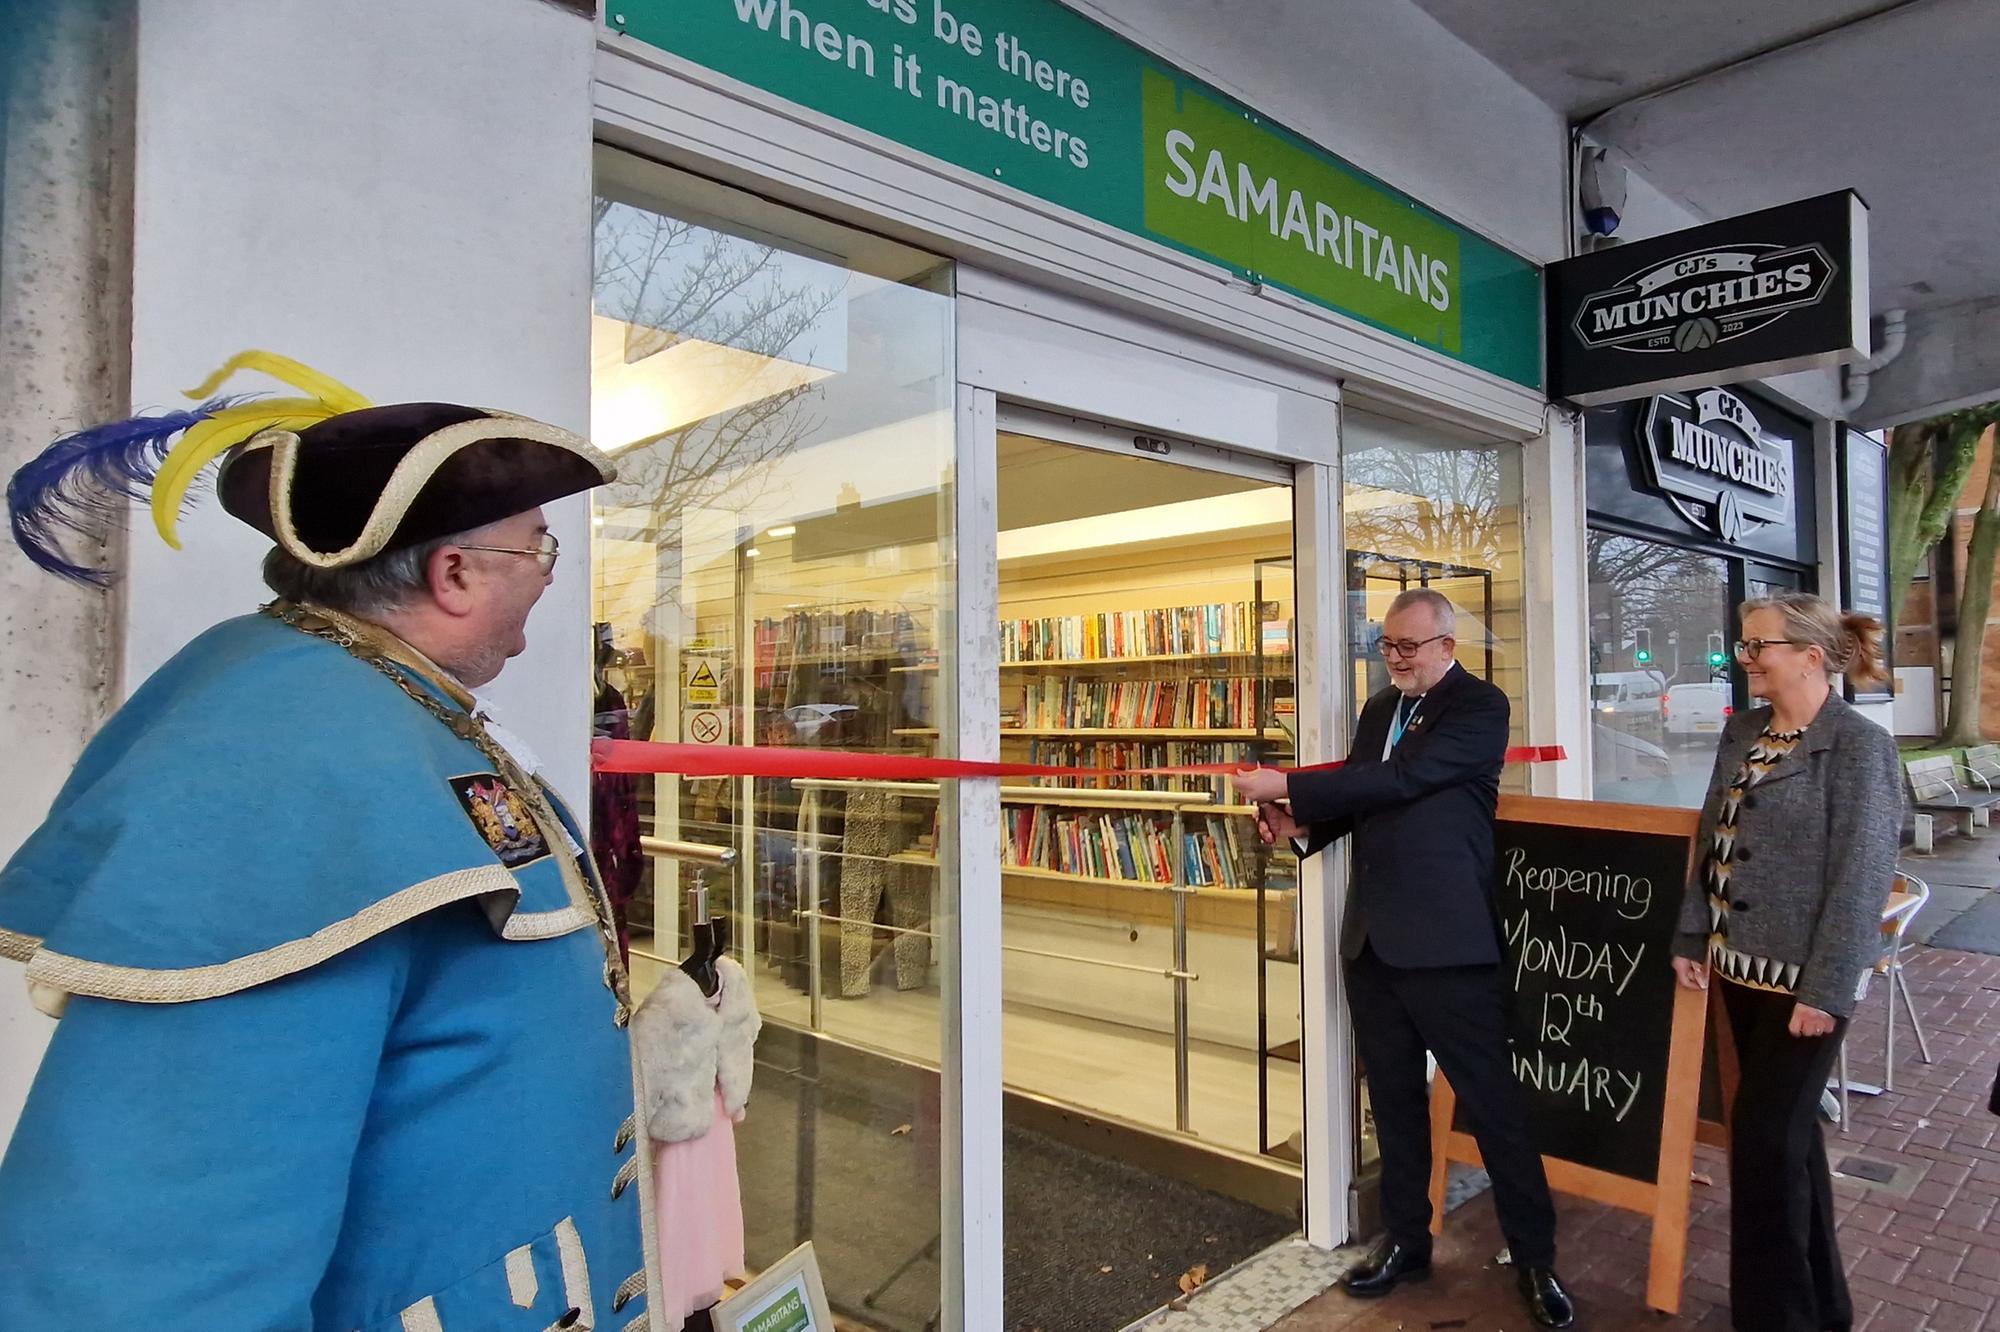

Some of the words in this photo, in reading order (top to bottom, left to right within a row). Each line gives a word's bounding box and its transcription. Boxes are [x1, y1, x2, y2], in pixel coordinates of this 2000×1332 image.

[734, 0, 875, 77] when
[894, 44, 922, 98] it
[937, 75, 1089, 169] matters
[934, 0, 983, 56] be
[995, 32, 1089, 108] there
[1165, 129, 1449, 311] SAMARITANS
[1593, 263, 1812, 333] MUNCHIES
[1675, 257, 1717, 276] CJ's
[1648, 336, 1670, 347] ESTD
[1722, 321, 1744, 333] 2023
[1671, 416, 1786, 497] MUNCHIES
[1505, 848, 1652, 919] Reopening
[1541, 992, 1603, 1047] 12th
[1508, 1039, 1640, 1122] NUARY
